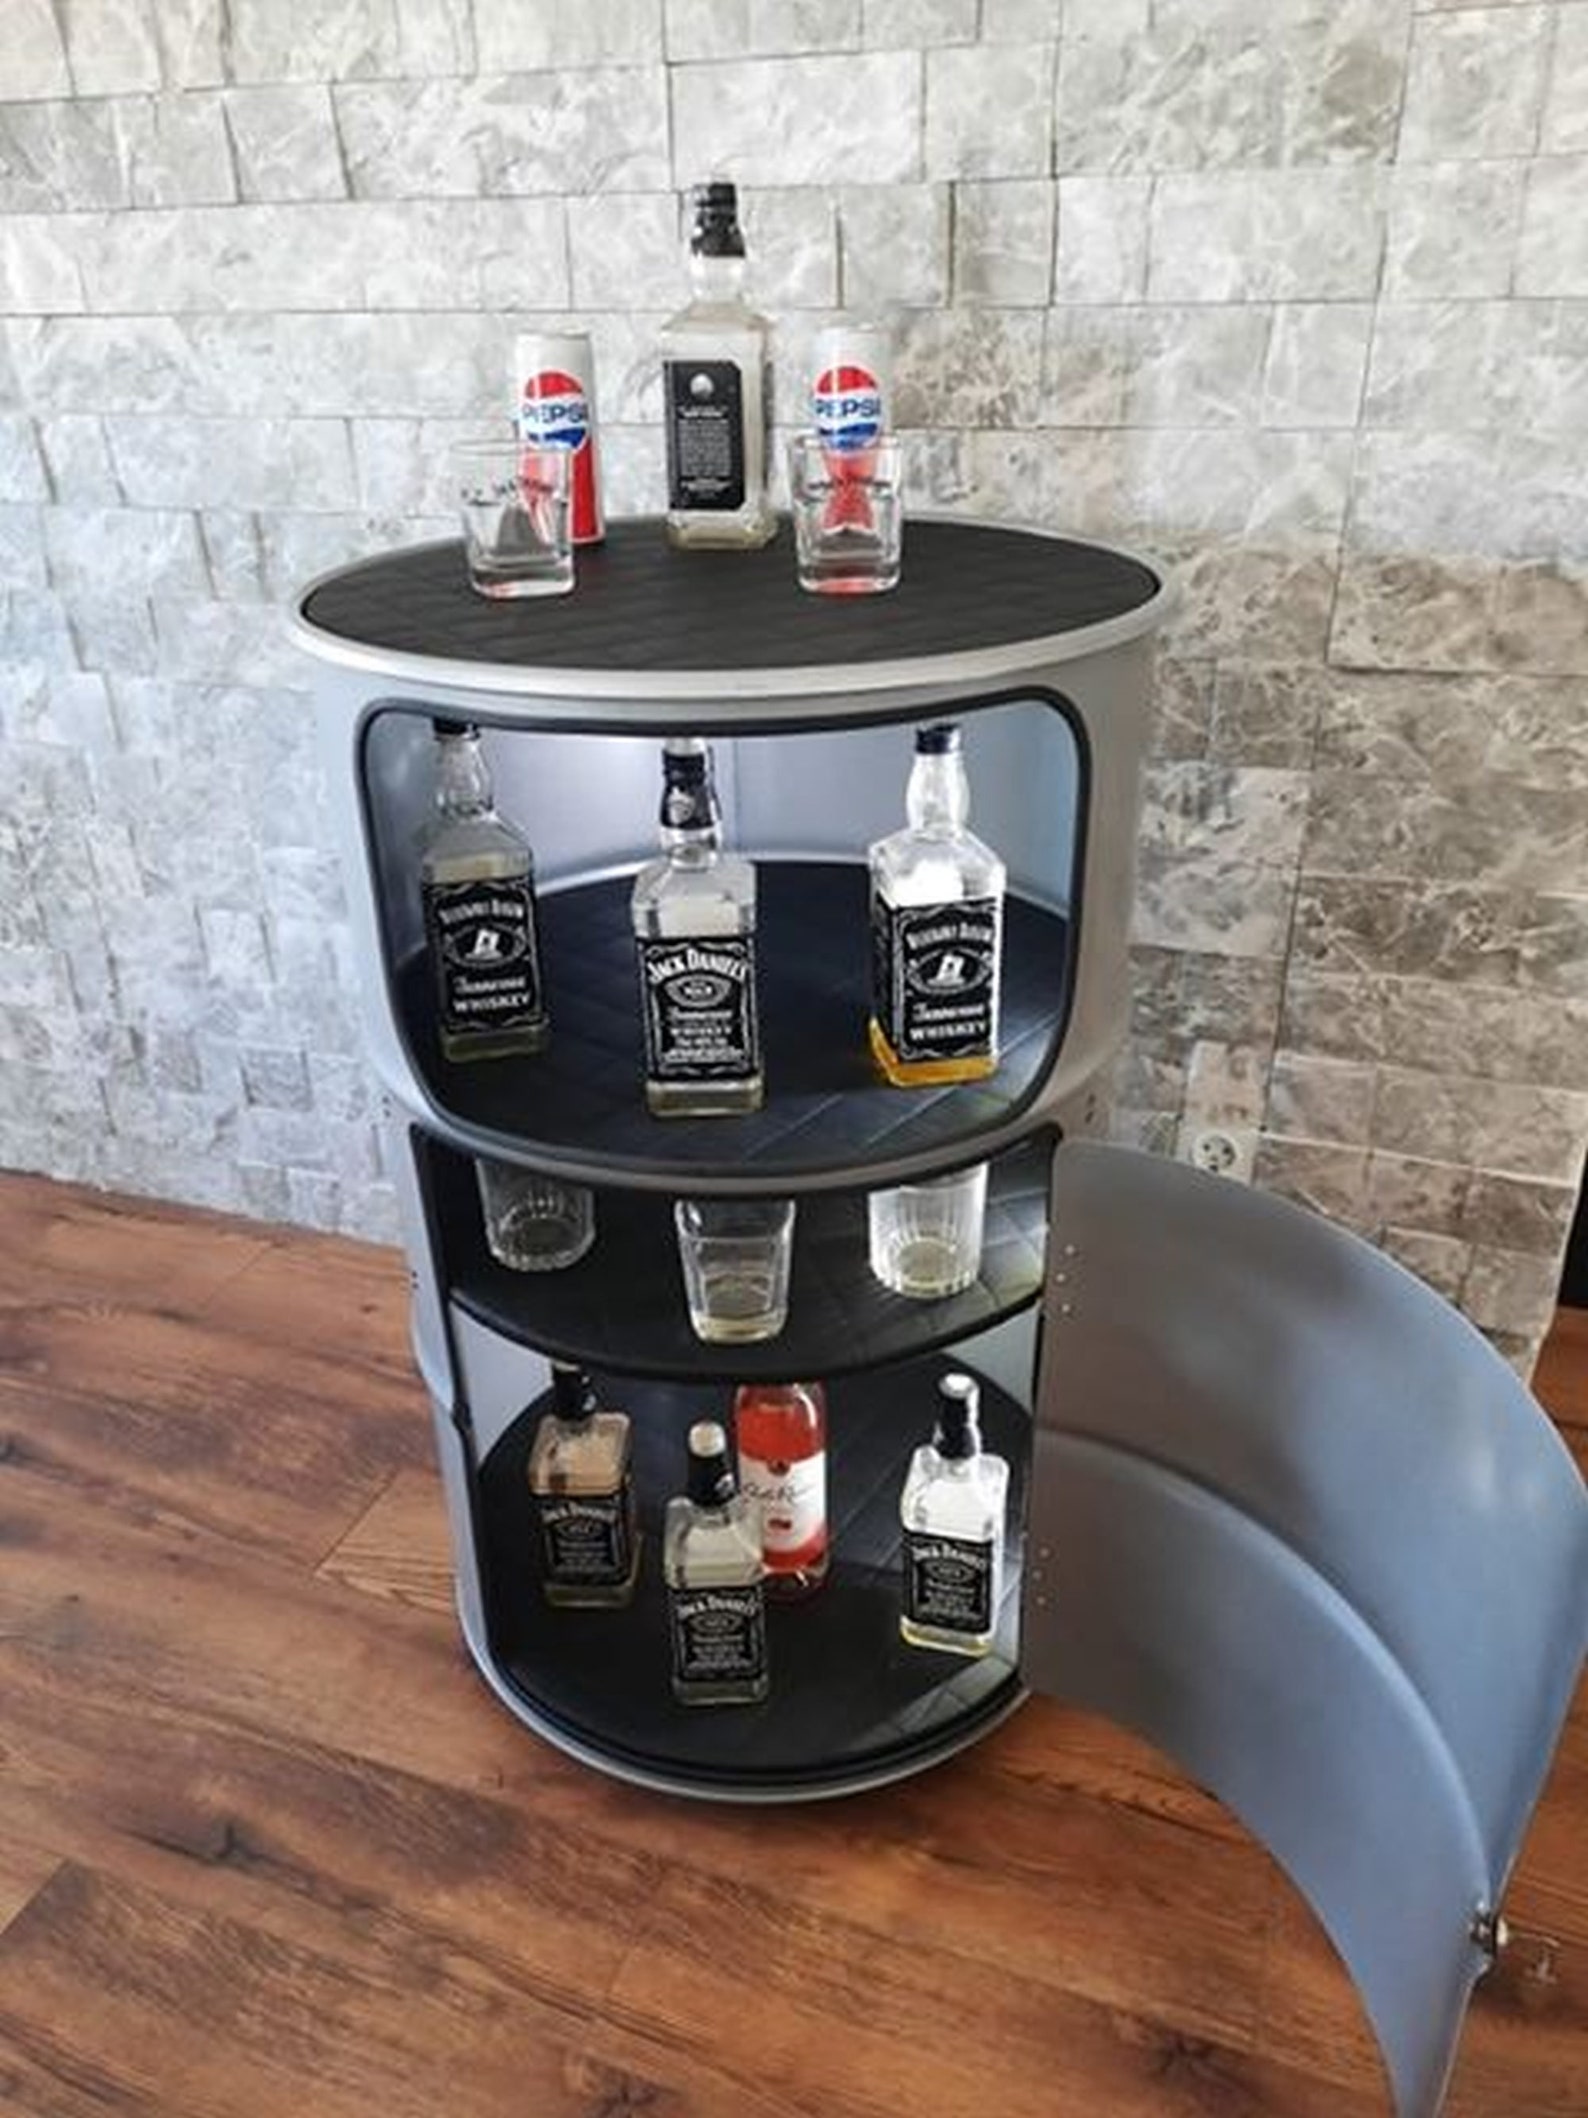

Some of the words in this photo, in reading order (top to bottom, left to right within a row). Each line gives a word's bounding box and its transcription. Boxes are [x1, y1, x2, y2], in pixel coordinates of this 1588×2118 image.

[521, 402, 589, 424] PEPSI
[814, 397, 881, 418] PEPSI
[647, 955, 686, 984] JACK
